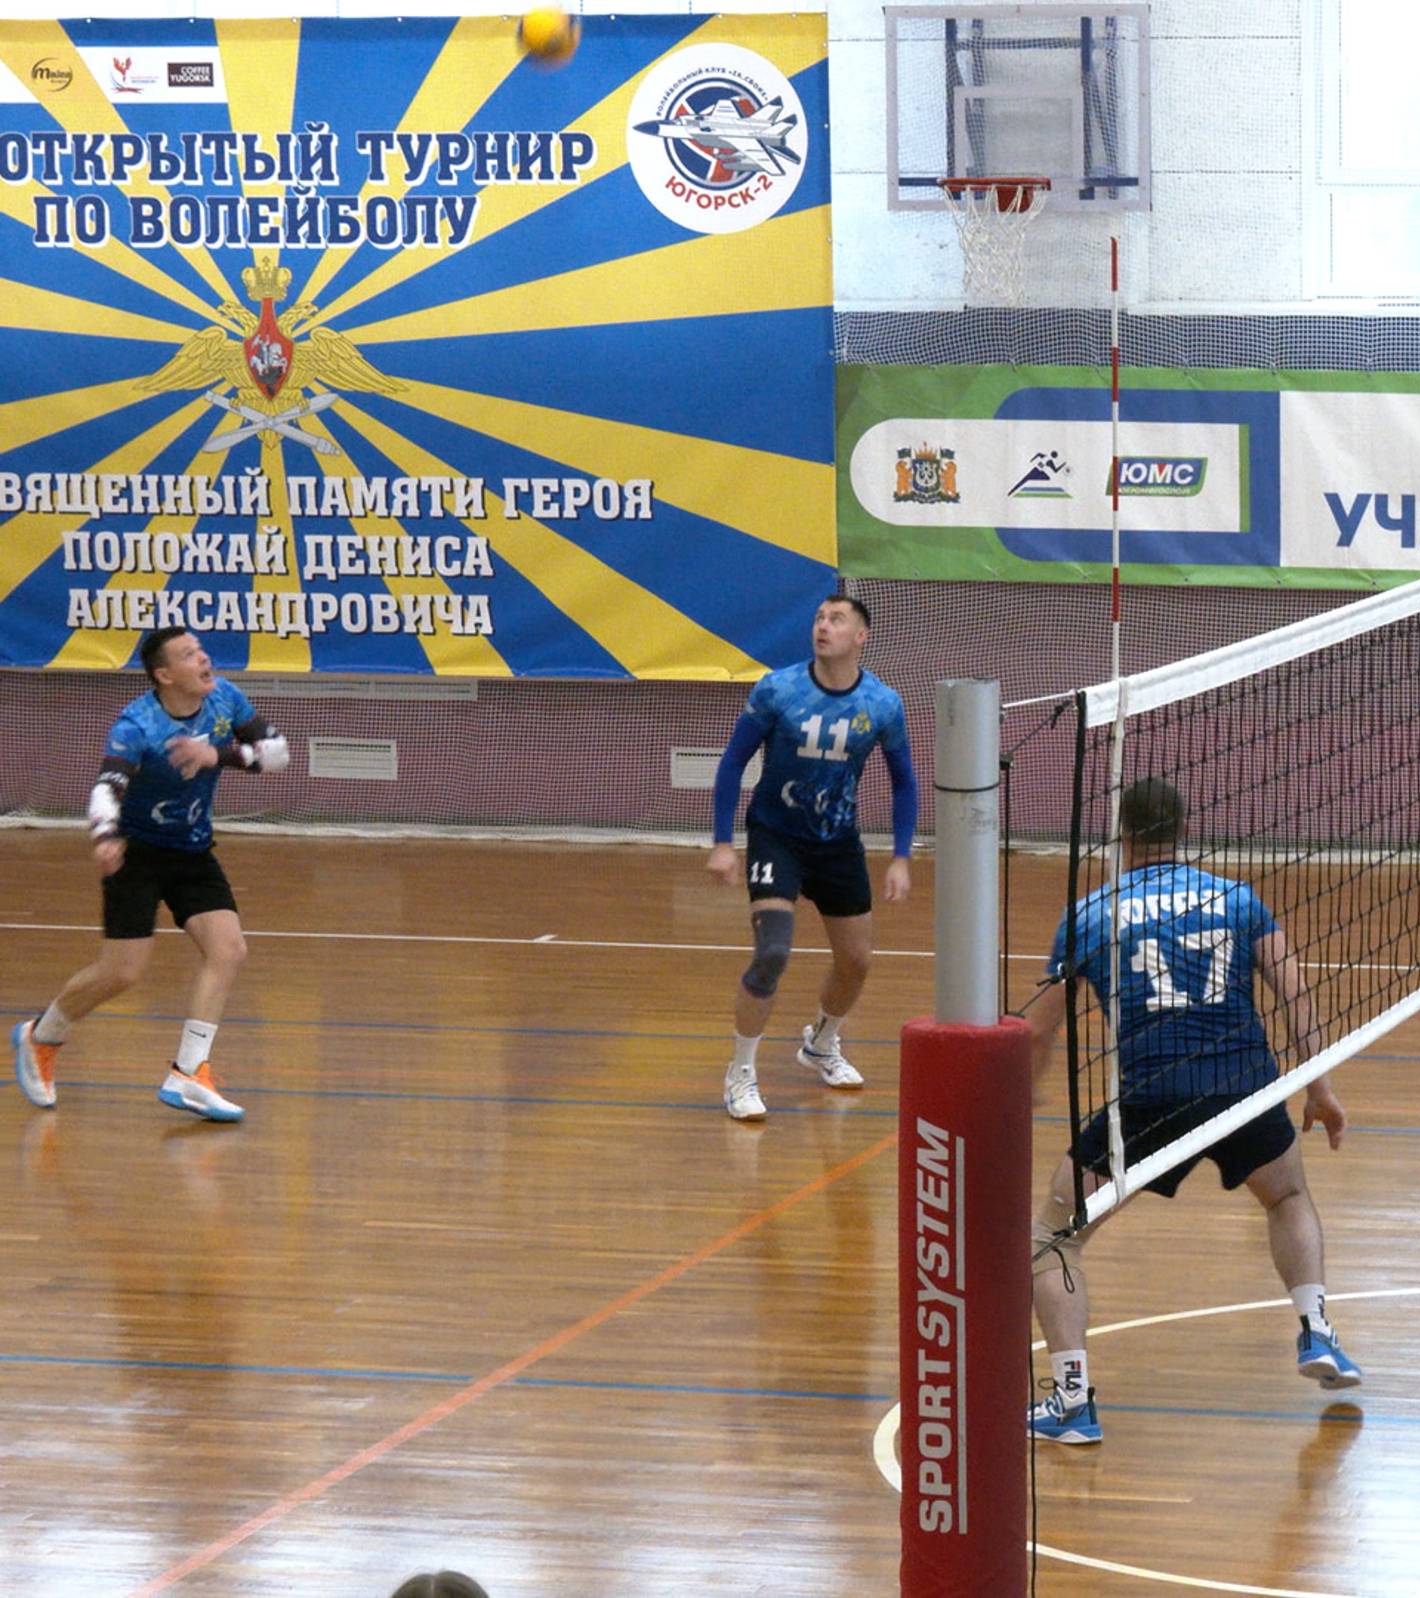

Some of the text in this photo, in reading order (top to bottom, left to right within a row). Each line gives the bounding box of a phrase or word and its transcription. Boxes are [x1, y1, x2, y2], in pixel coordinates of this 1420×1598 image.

[0, 121, 599, 186] ОТКРЫТЫЙ ТУРНИР
[33, 185, 480, 249] ПО ВОЛЕЙБОЛУ
[665, 174, 773, 210] ЮГОРСК-2
[0, 467, 653, 519] ВЯЩЕННЫЙ ПАМЯТИ ГЕРОЯ
[1119, 462, 1195, 485] ЮМС
[61, 525, 495, 581] ПОЛОЖАЙ ДЕНИСА
[66, 588, 495, 638] АЛЕКСАНДРОВИЧА
[797, 714, 849, 762] 11
[749, 861, 774, 884] 11
[1130, 928, 1234, 1012] 17
[916, 1117, 966, 1534] SPORT SYSTEM
[1064, 1360, 1082, 1391] FILA
